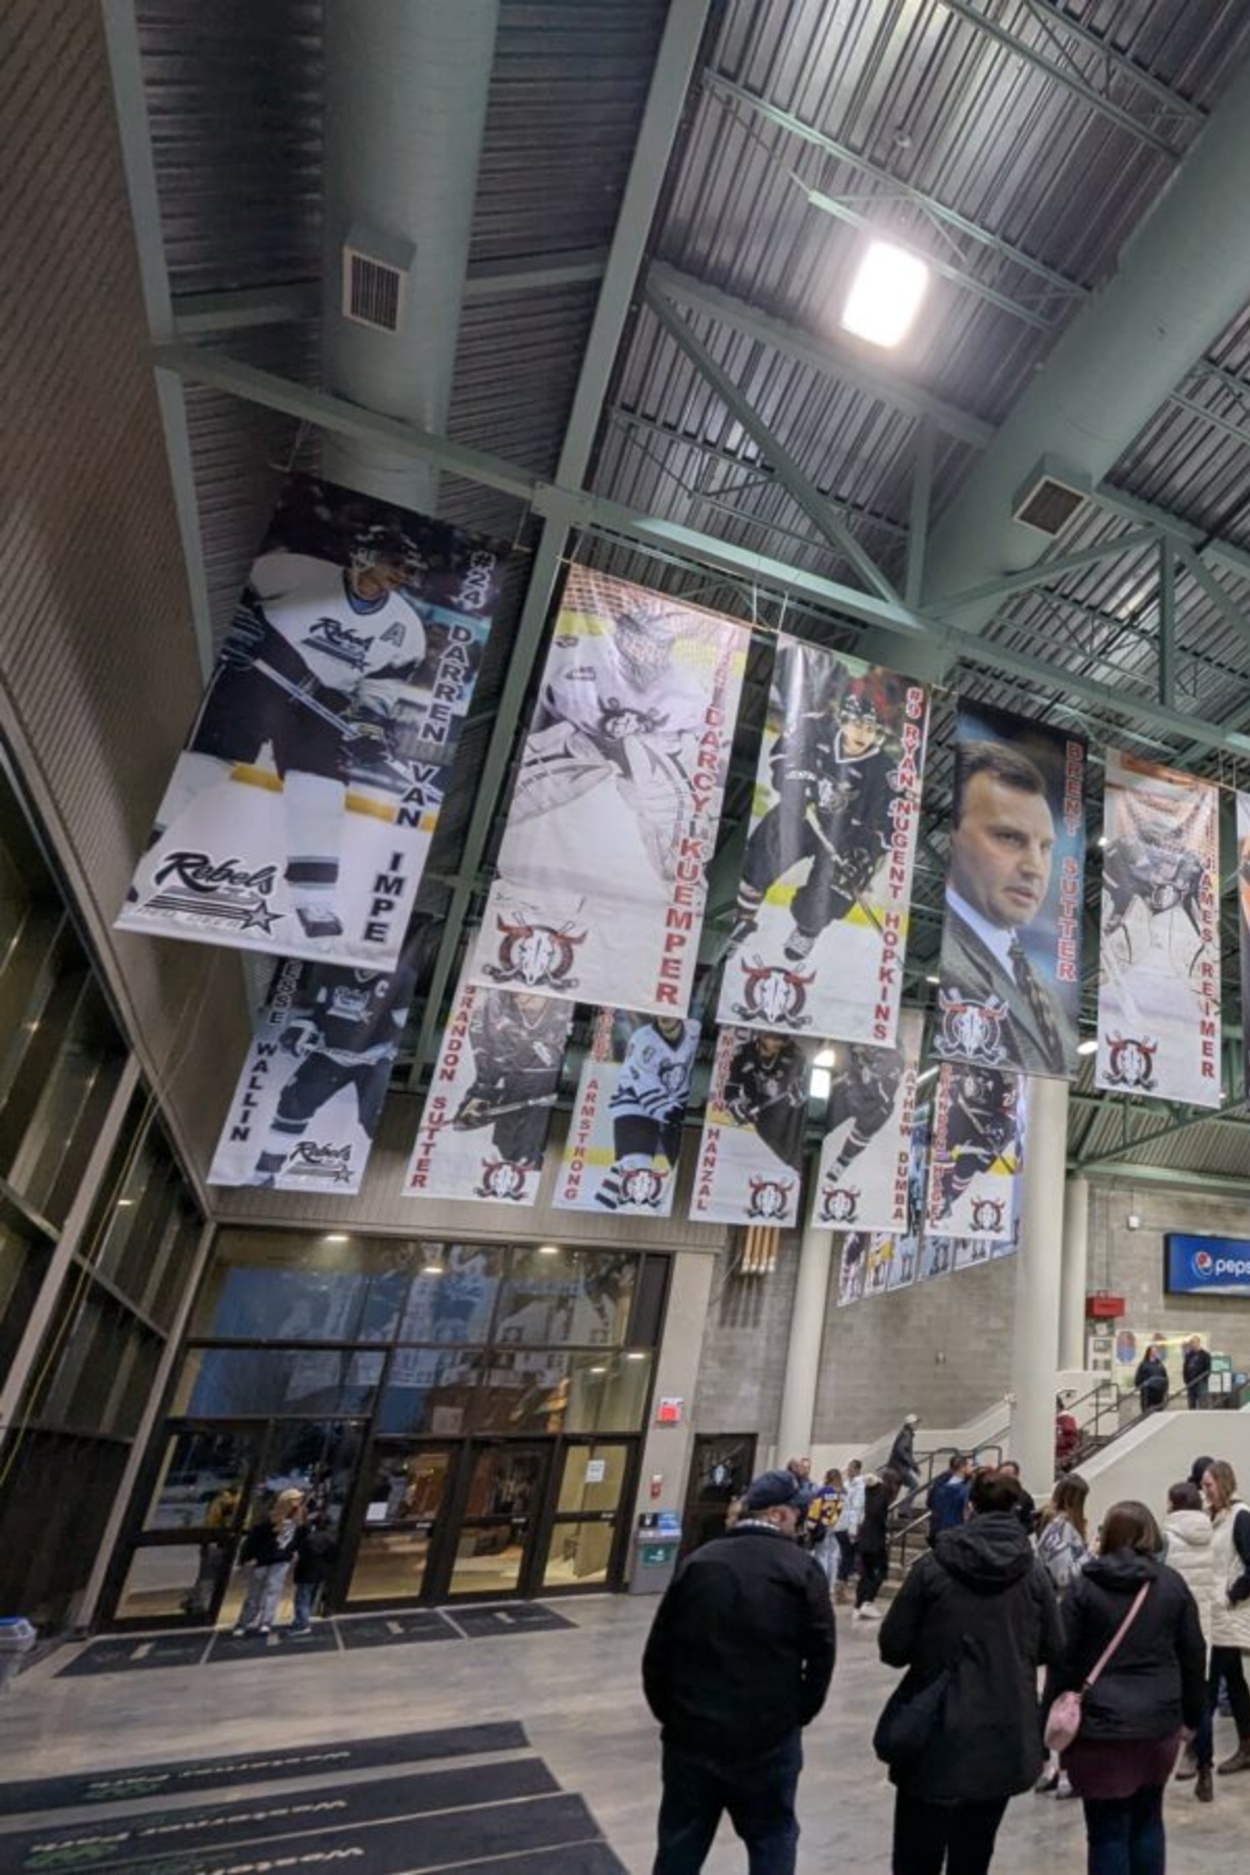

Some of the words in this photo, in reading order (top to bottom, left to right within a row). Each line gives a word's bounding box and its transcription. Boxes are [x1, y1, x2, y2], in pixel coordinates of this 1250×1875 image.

[461, 551, 495, 609] #24
[380, 621, 406, 648] A
[419, 625, 473, 744] DARREN
[397, 763, 440, 829] VAN
[692, 707, 722, 814] DARCY
[899, 724, 919, 789] RYAN
[155, 852, 277, 894] Rebels
[889, 800, 913, 899] NUGENT
[363, 852, 405, 943] IMPE
[655, 838, 699, 1005] KUEMPER
[1057, 858, 1079, 983] SUTTER
[1200, 857, 1214, 943] JAMES
[268, 961, 301, 1024] ESSE
[872, 912, 900, 1040] HOPKINS
[1200, 963, 1216, 1079] REIMER
[230, 1041, 278, 1142] WALLIN
[900, 1068, 918, 1136] ATHEW
[410, 1096, 447, 1189] SUTTER
[564, 1079, 599, 1200] ARMSTRONG
[697, 1128, 720, 1211] HANZAL
[892, 1151, 909, 1220] DUMBA
